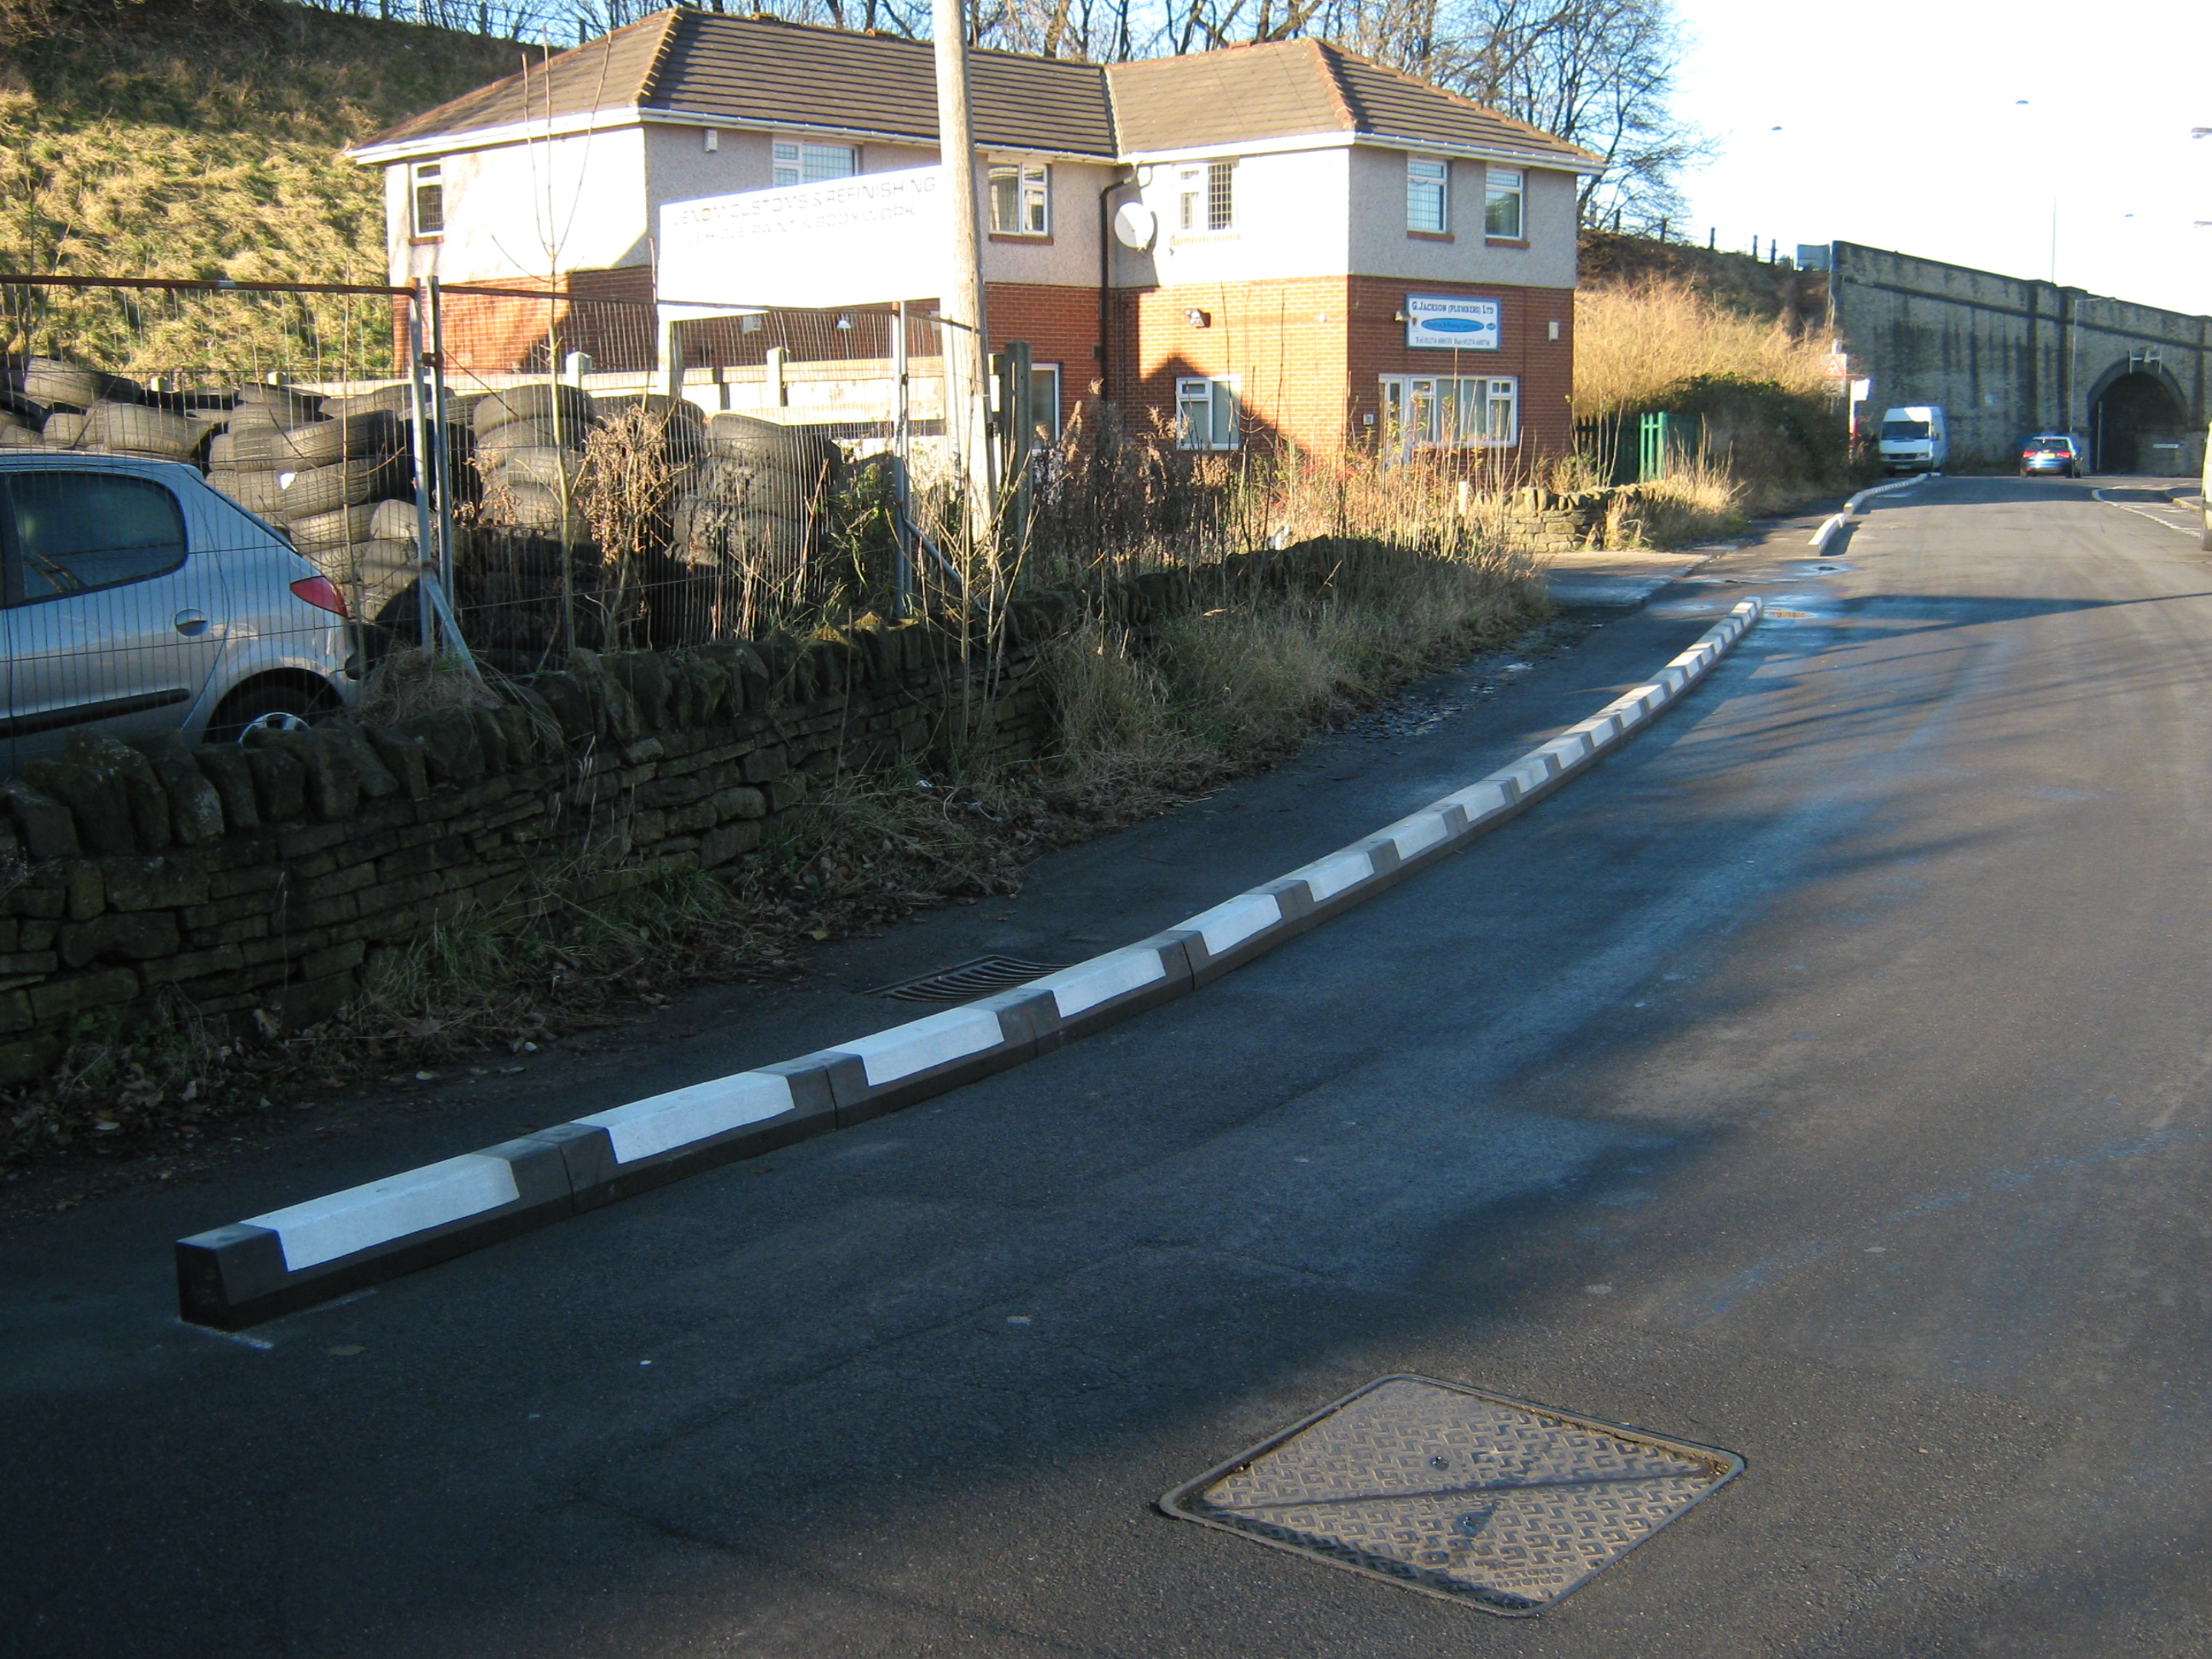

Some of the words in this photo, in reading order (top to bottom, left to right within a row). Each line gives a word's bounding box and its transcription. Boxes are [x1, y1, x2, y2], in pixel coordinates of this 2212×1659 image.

[672, 205, 726, 225] ENOM
[826, 176, 936, 203] REFINISHING
[686, 226, 745, 245] EHCLE
[752, 219, 796, 235] PANT
[815, 205, 916, 229] BODYWORK
